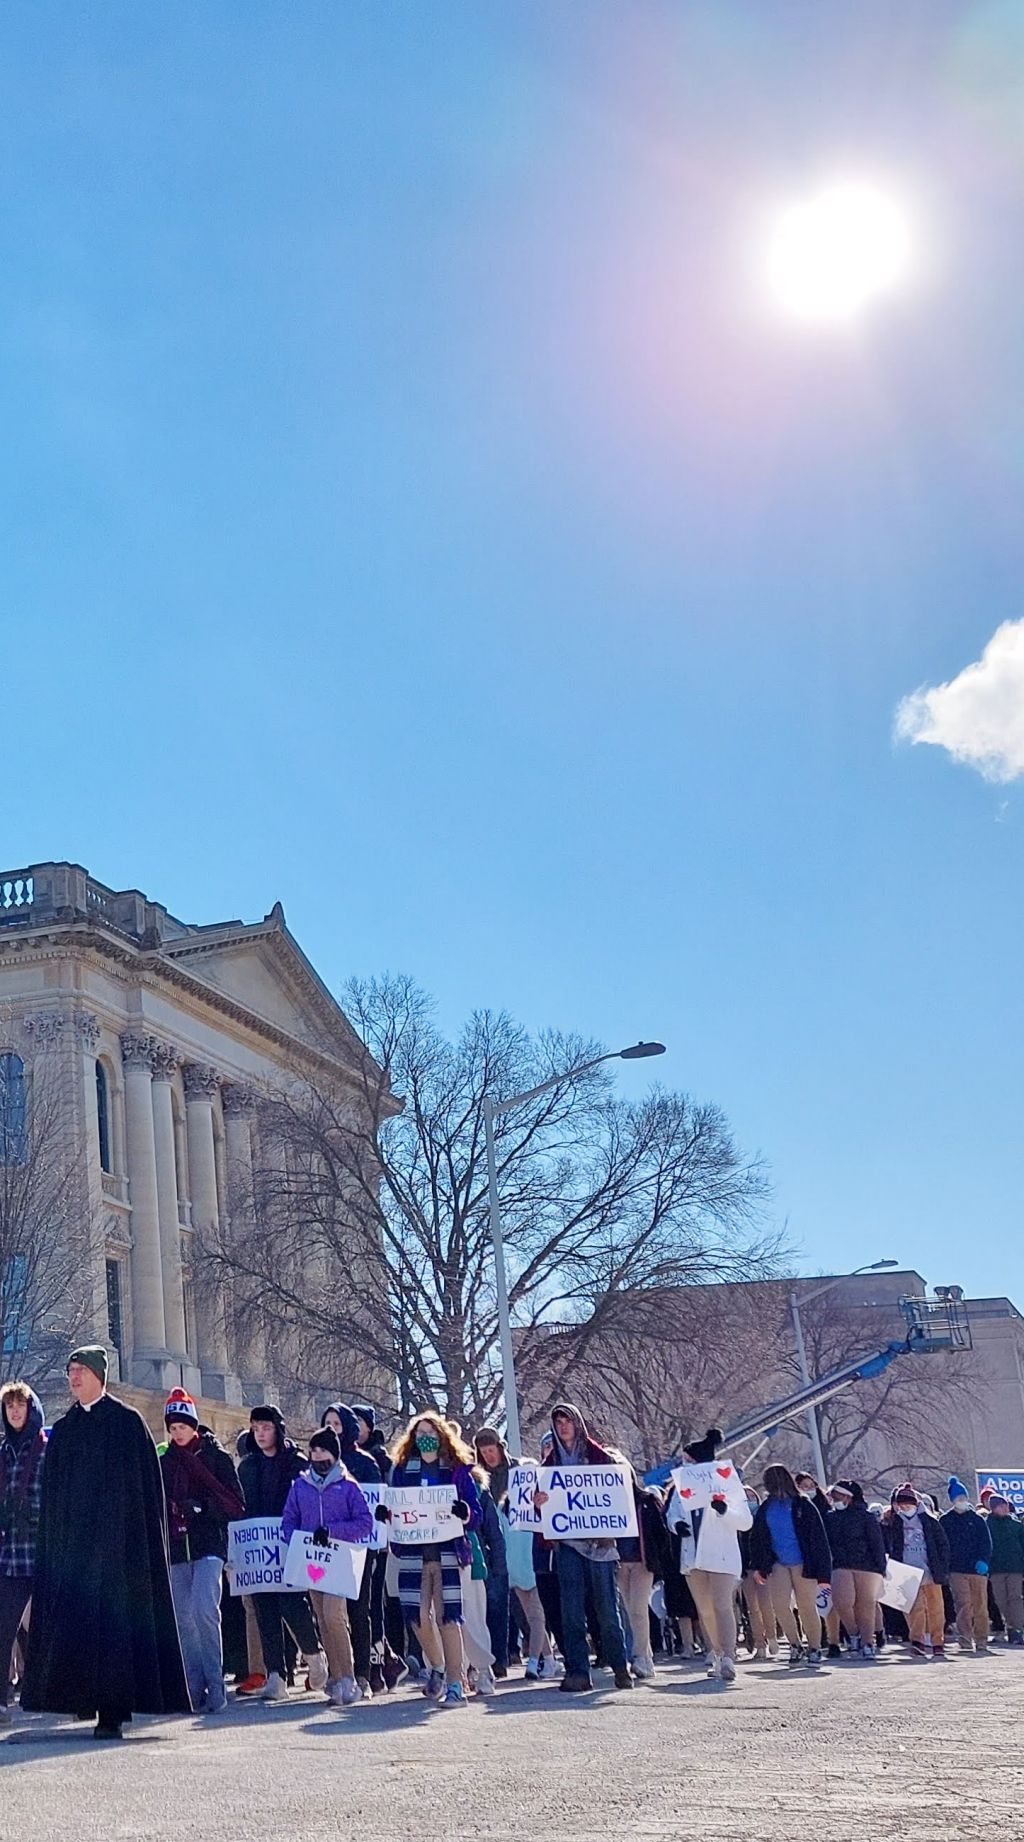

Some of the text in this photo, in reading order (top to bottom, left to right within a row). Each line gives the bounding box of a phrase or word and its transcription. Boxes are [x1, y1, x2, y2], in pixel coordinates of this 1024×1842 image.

[166, 1402, 189, 1413] SA
[549, 1470, 624, 1491] ABORTION
[566, 1490, 612, 1511] KILLS
[551, 1512, 628, 1533] CHILDREN
[244, 1545, 281, 1566] KILLS
[305, 1549, 332, 1563] LIFE
